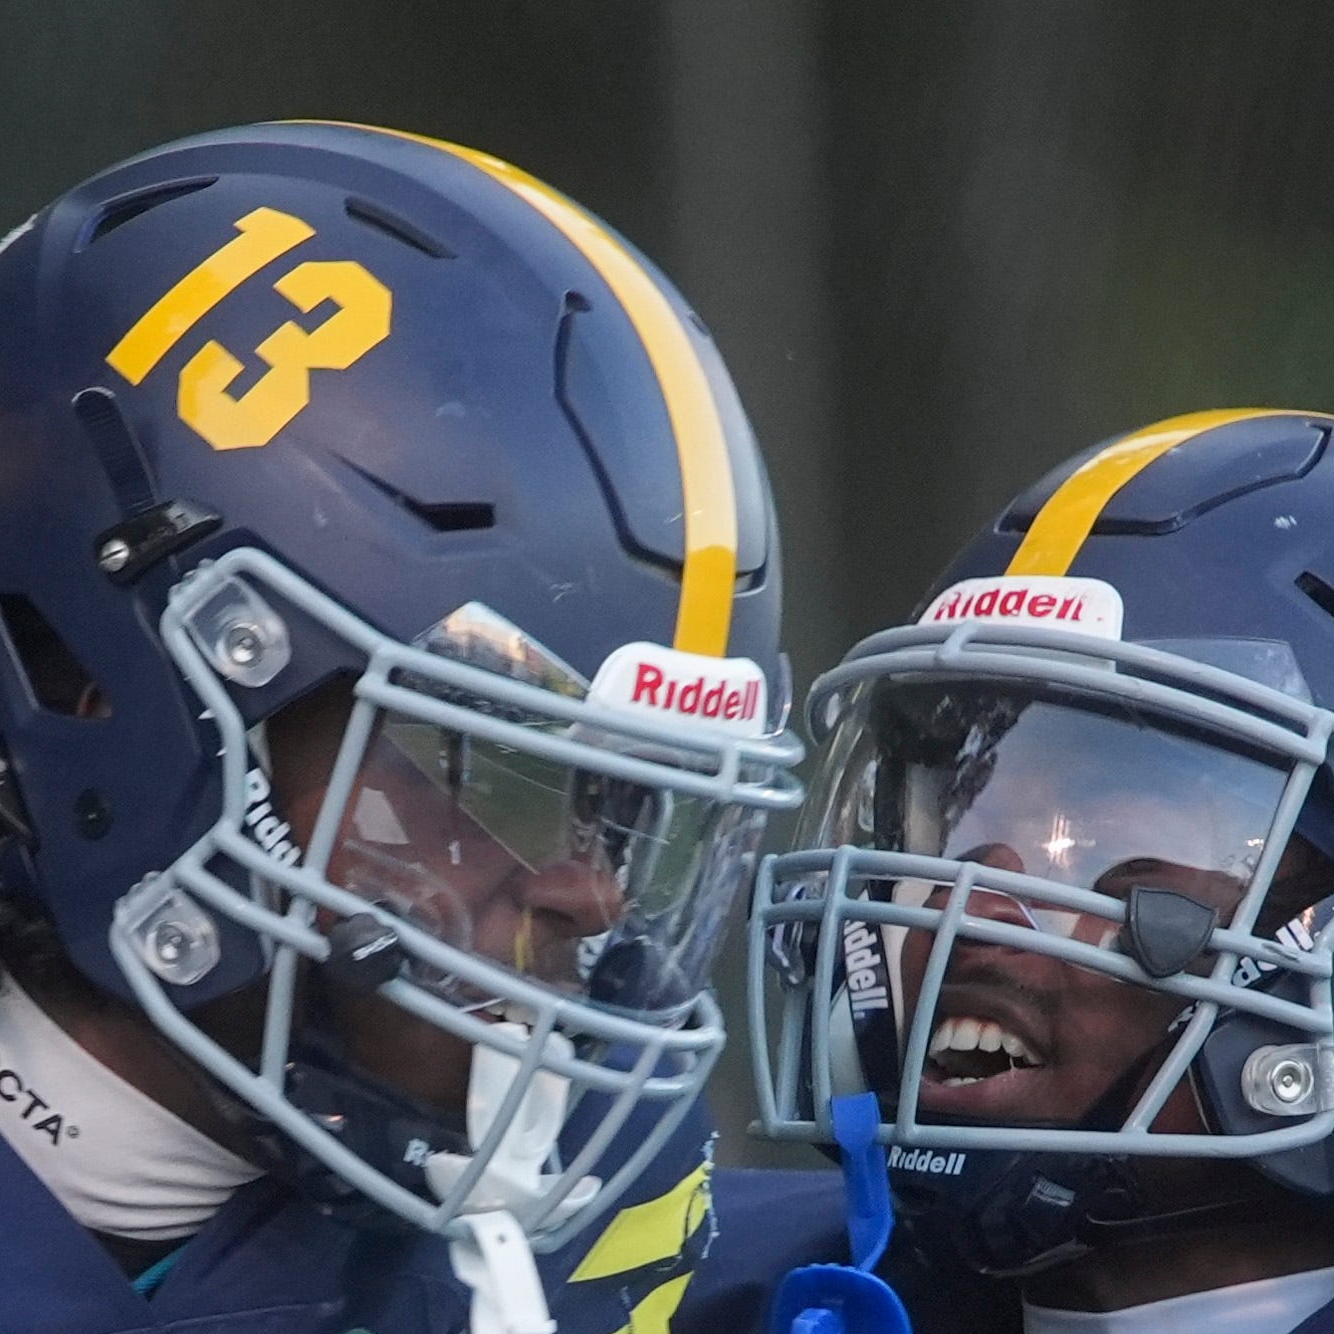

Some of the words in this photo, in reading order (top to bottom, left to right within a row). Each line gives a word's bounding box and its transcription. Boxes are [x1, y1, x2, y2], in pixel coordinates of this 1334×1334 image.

[105, 206, 393, 451] 13
[933, 587, 1088, 622] Riddell
[630, 662, 761, 721] Riddell
[244, 767, 302, 868] Ridd
[843, 920, 888, 1010] iddell
[887, 1146, 966, 1176] Riddell
